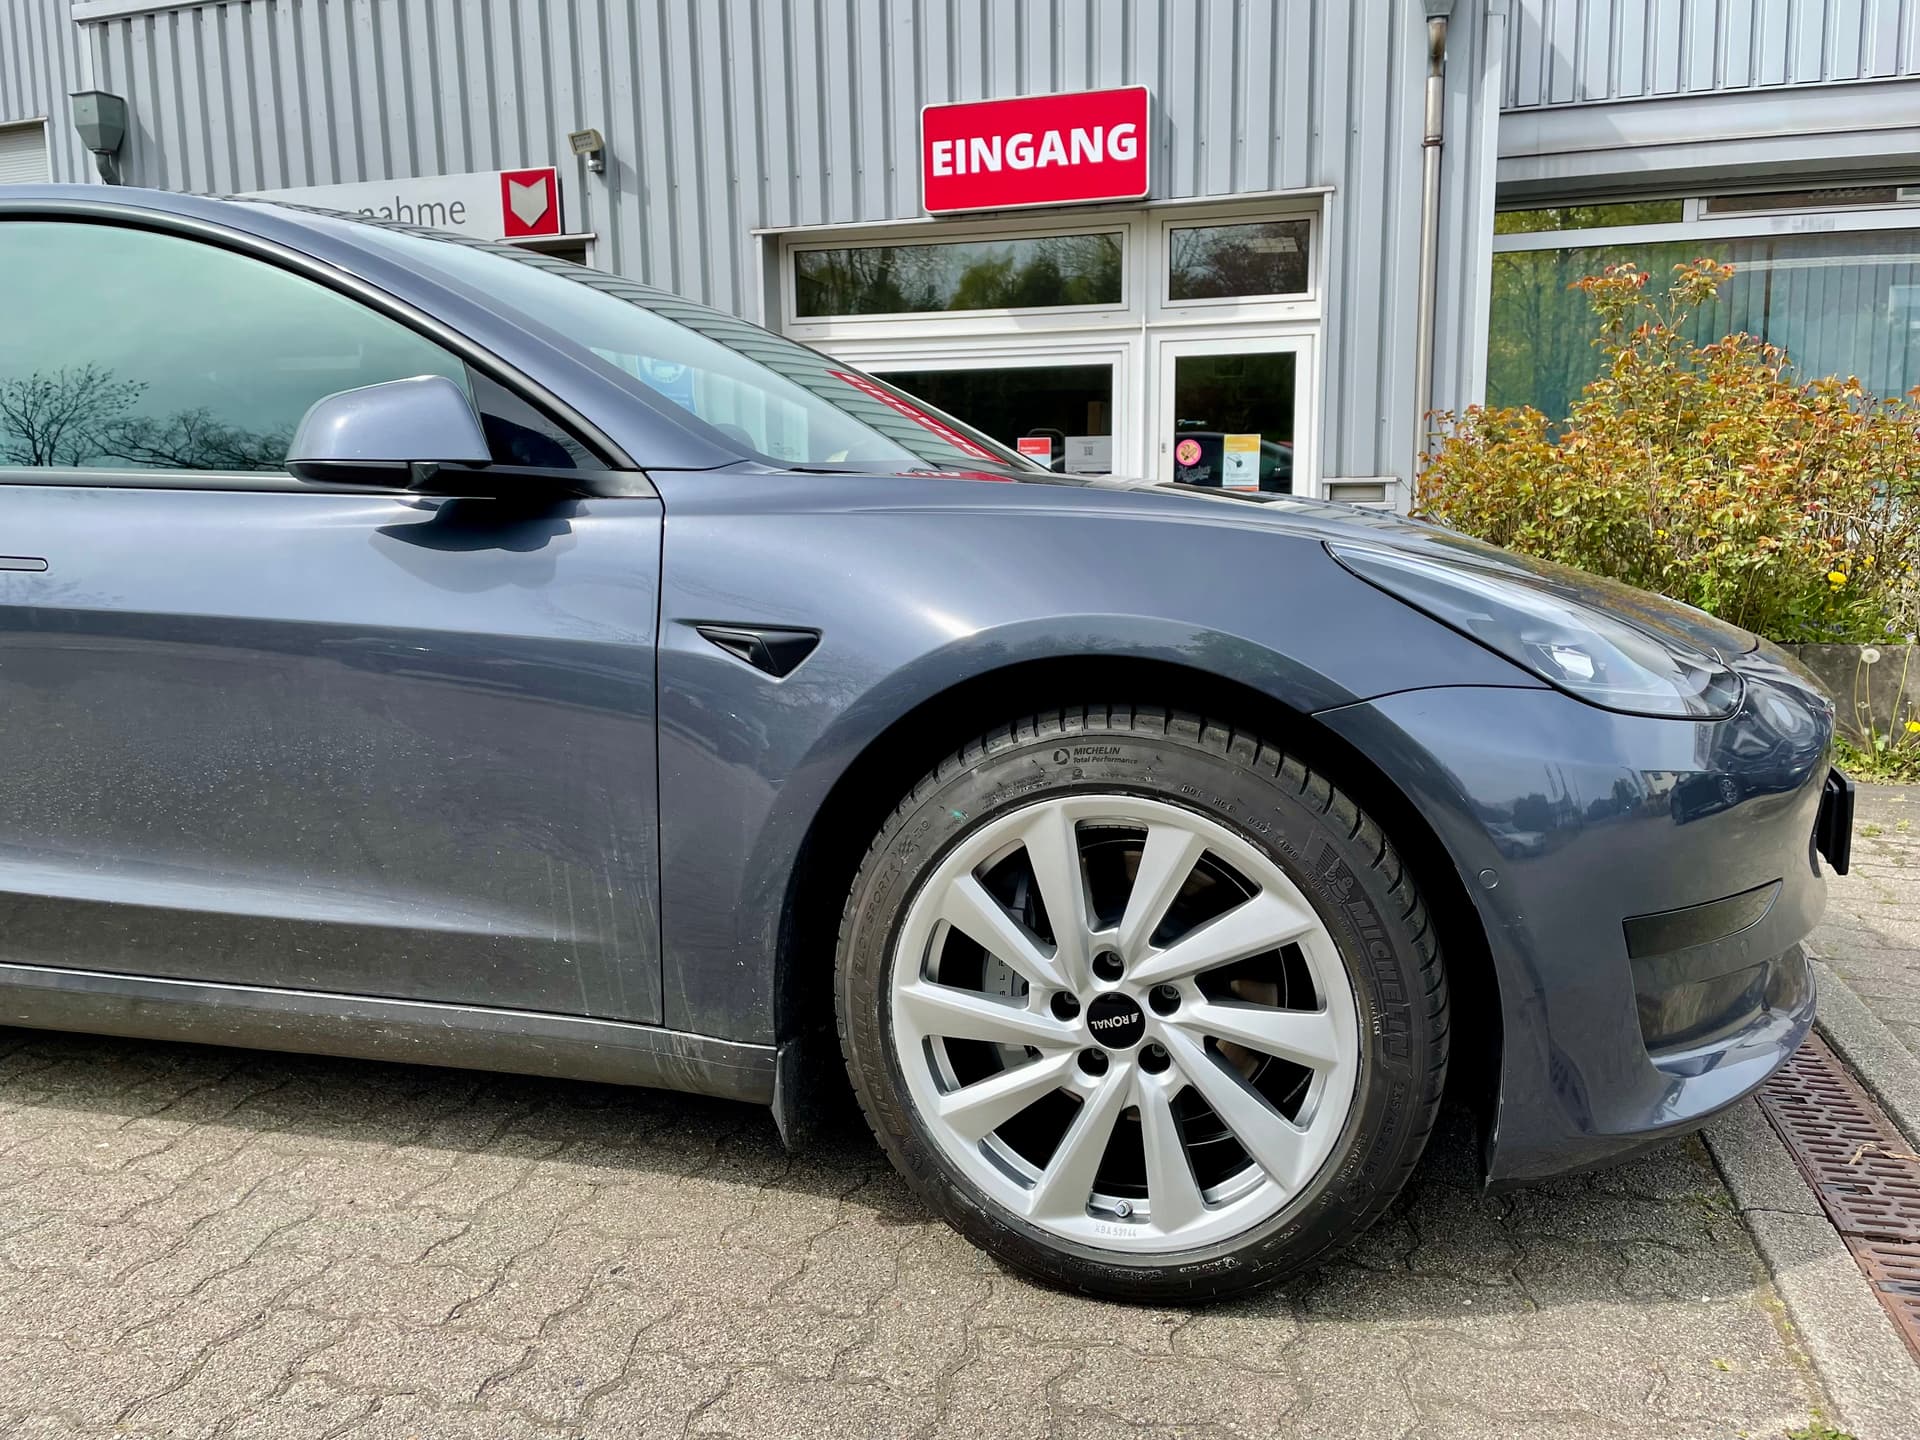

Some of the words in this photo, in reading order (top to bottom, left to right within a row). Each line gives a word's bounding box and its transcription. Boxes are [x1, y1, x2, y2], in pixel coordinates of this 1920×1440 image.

[932, 123, 1138, 178] EINGANG
[1073, 746, 1121, 756] MICHELIN
[1073, 756, 1090, 764] Total
[1091, 756, 1138, 765] Performance
[865, 871, 892, 925] SPORT
[1347, 898, 1411, 1063] MICHELIN
[1090, 1015, 1130, 1030] RONAL
